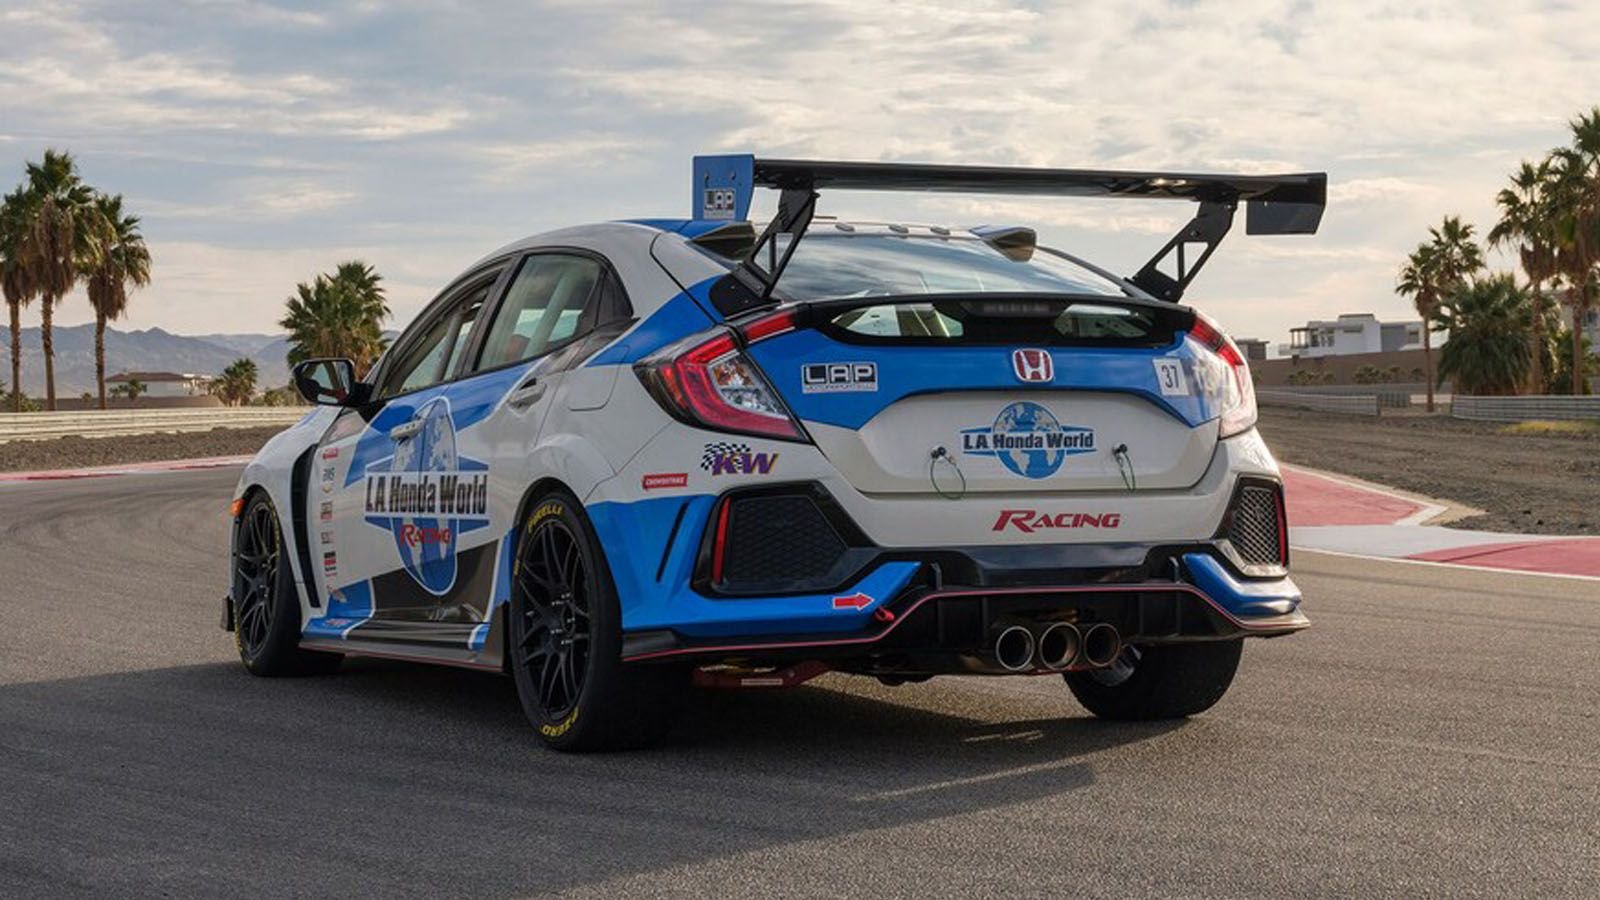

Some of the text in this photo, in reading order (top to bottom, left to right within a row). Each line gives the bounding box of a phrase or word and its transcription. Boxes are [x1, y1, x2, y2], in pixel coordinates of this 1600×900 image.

[805, 365, 873, 382] LAP
[1161, 365, 1179, 388] 37
[993, 433, 1043, 449] Honda
[1046, 432, 1094, 448] World
[711, 451, 779, 476] KW
[388, 475, 436, 513] Honda
[440, 474, 487, 514] World
